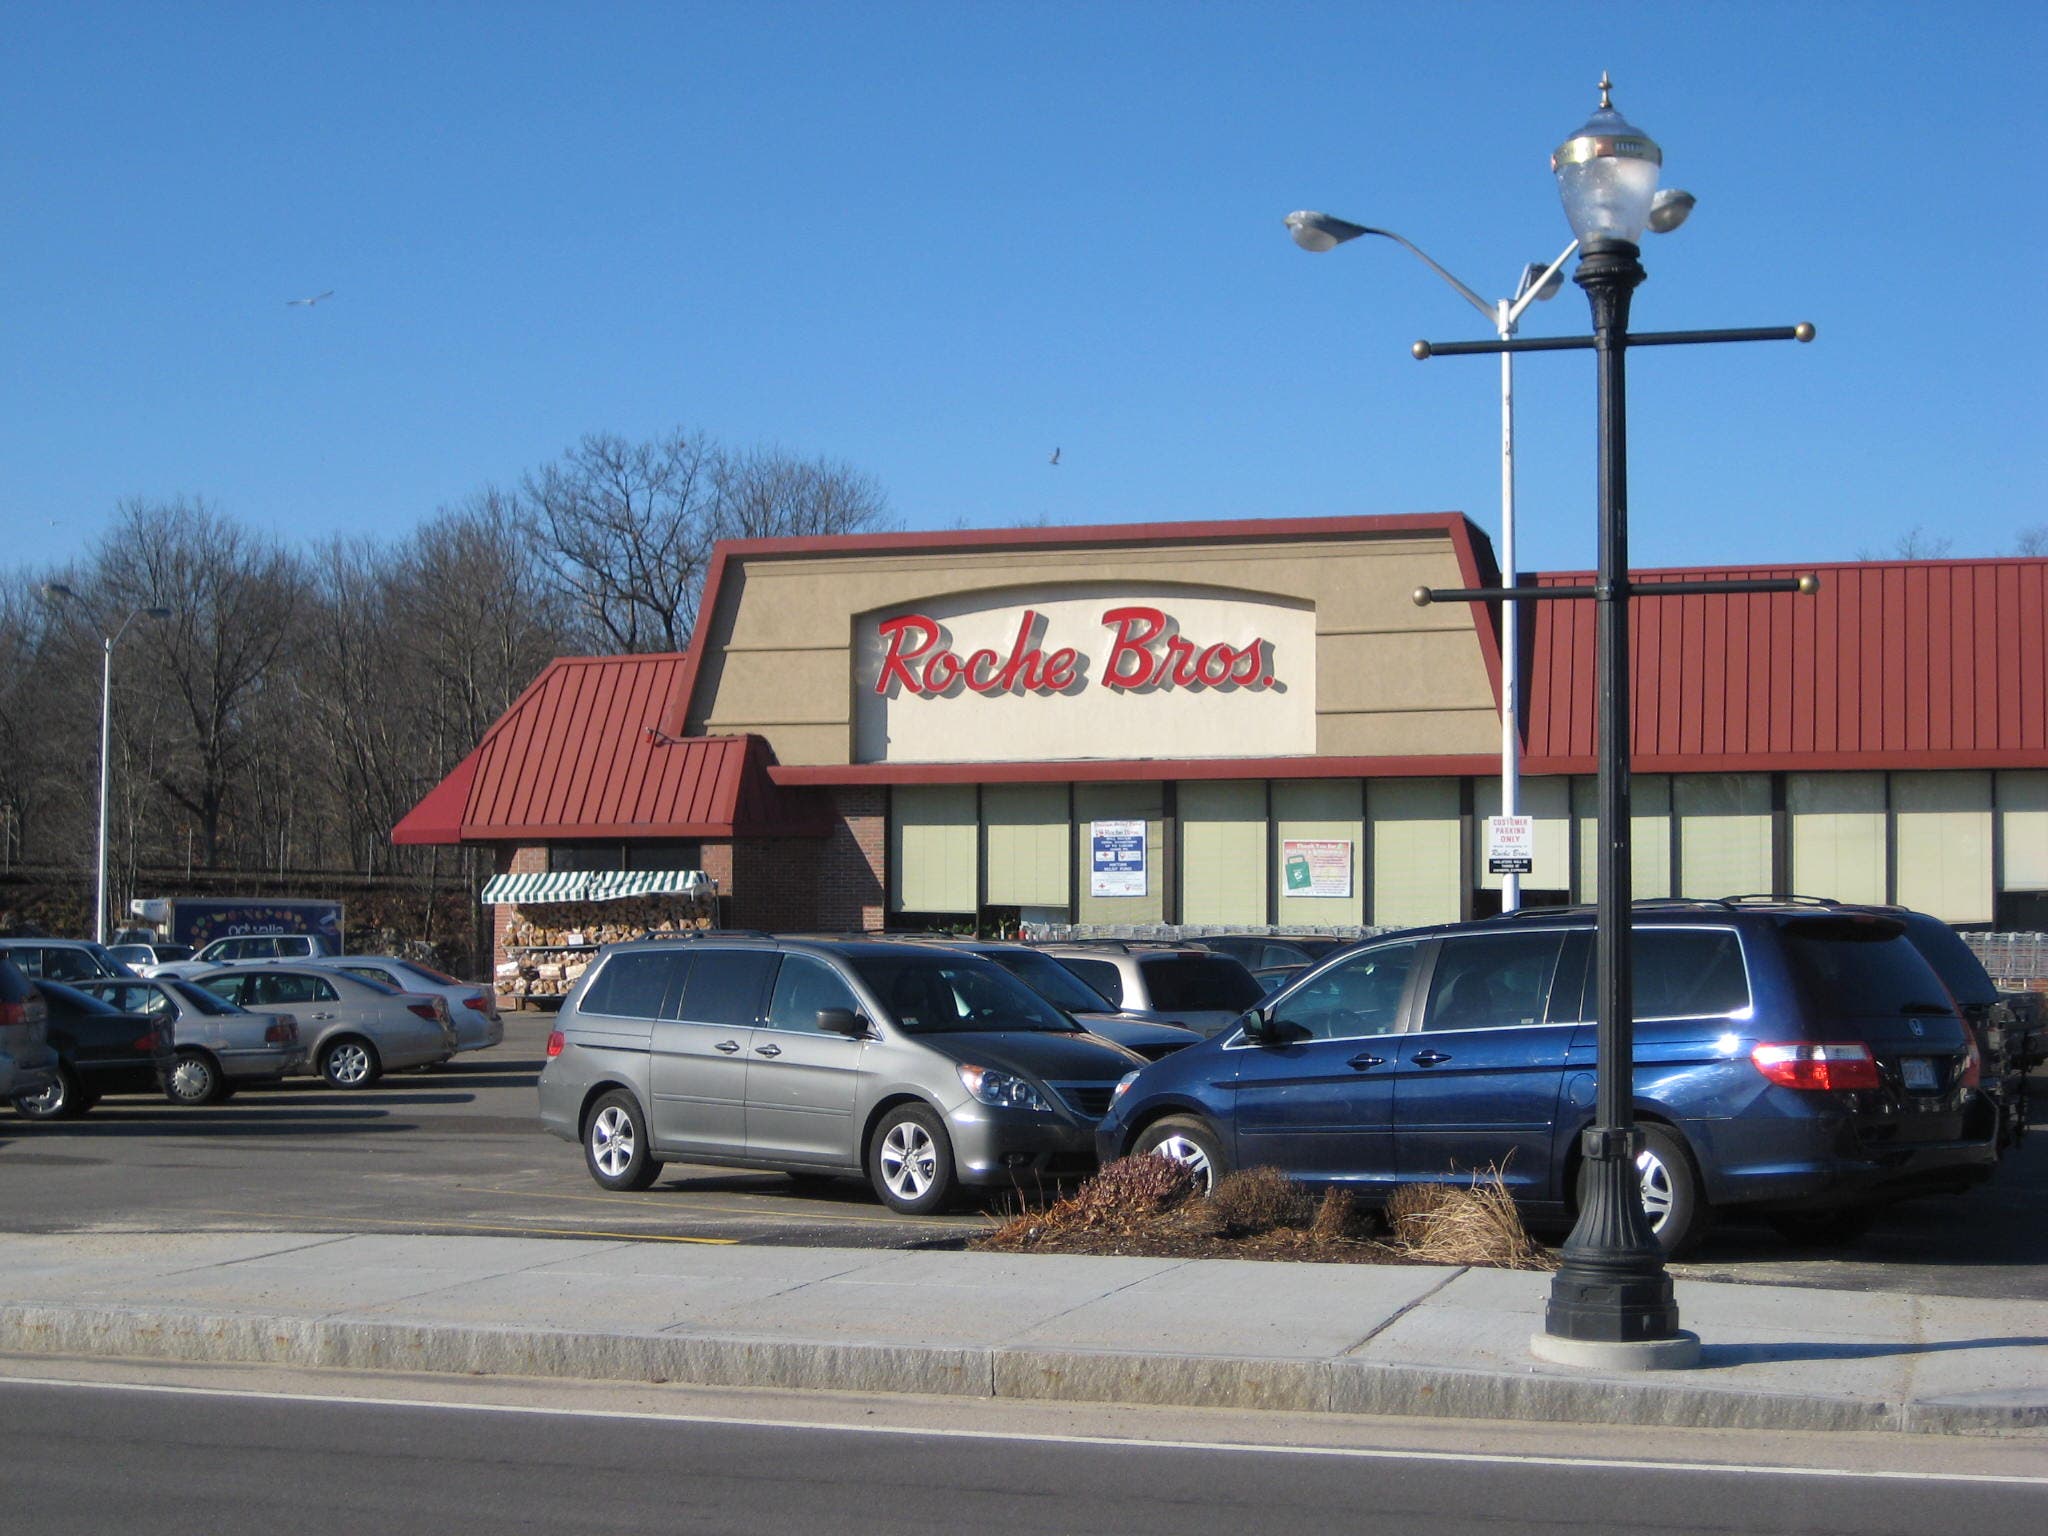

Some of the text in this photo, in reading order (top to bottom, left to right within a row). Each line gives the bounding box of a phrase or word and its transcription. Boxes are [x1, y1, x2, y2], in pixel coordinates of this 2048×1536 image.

[874, 606, 1276, 695] Roche Bros.
[1495, 827, 1526, 835] PARKING
[1500, 835, 1520, 843] ONLY
